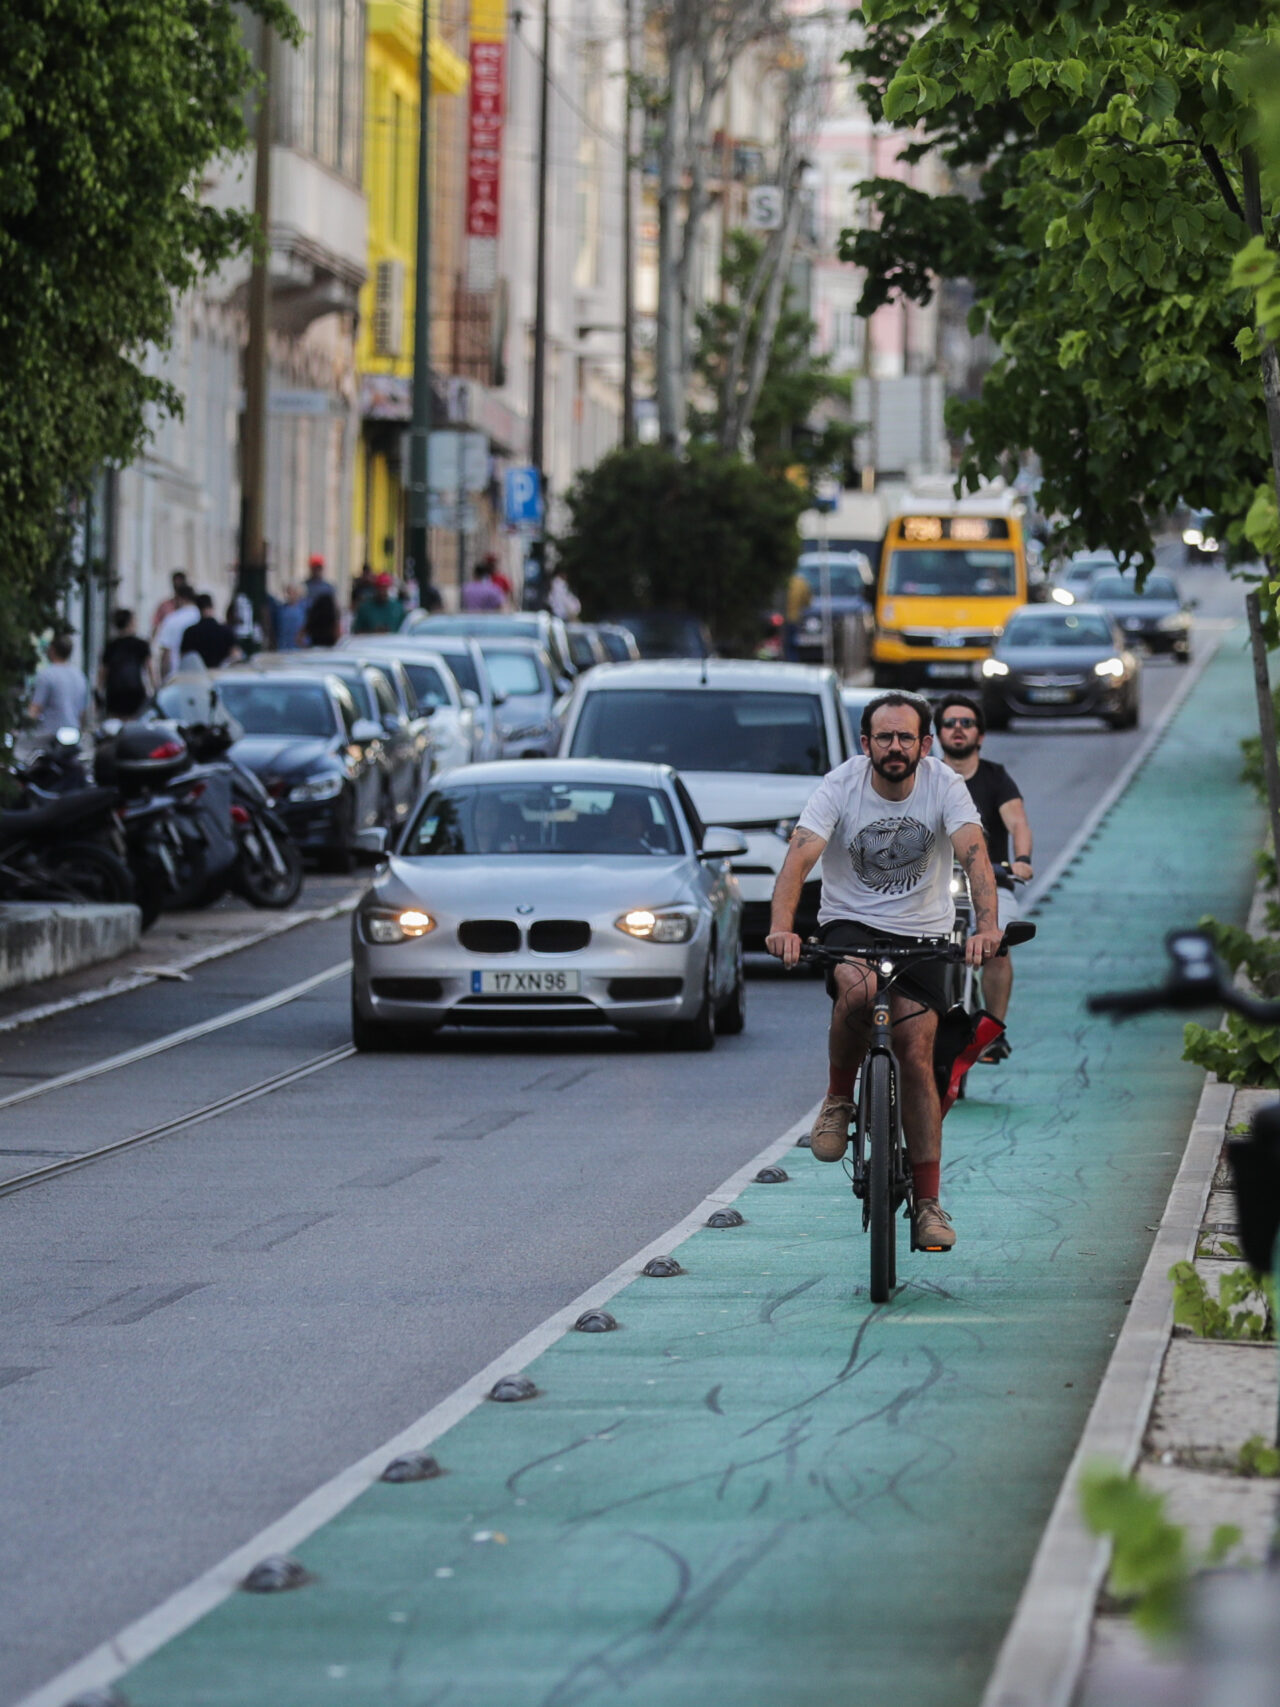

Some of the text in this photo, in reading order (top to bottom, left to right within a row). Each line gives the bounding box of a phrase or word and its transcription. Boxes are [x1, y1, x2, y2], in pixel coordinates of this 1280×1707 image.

[472, 44, 501, 234] RESIDENCIAL
[755, 193, 774, 222] S
[513, 471, 534, 514] P
